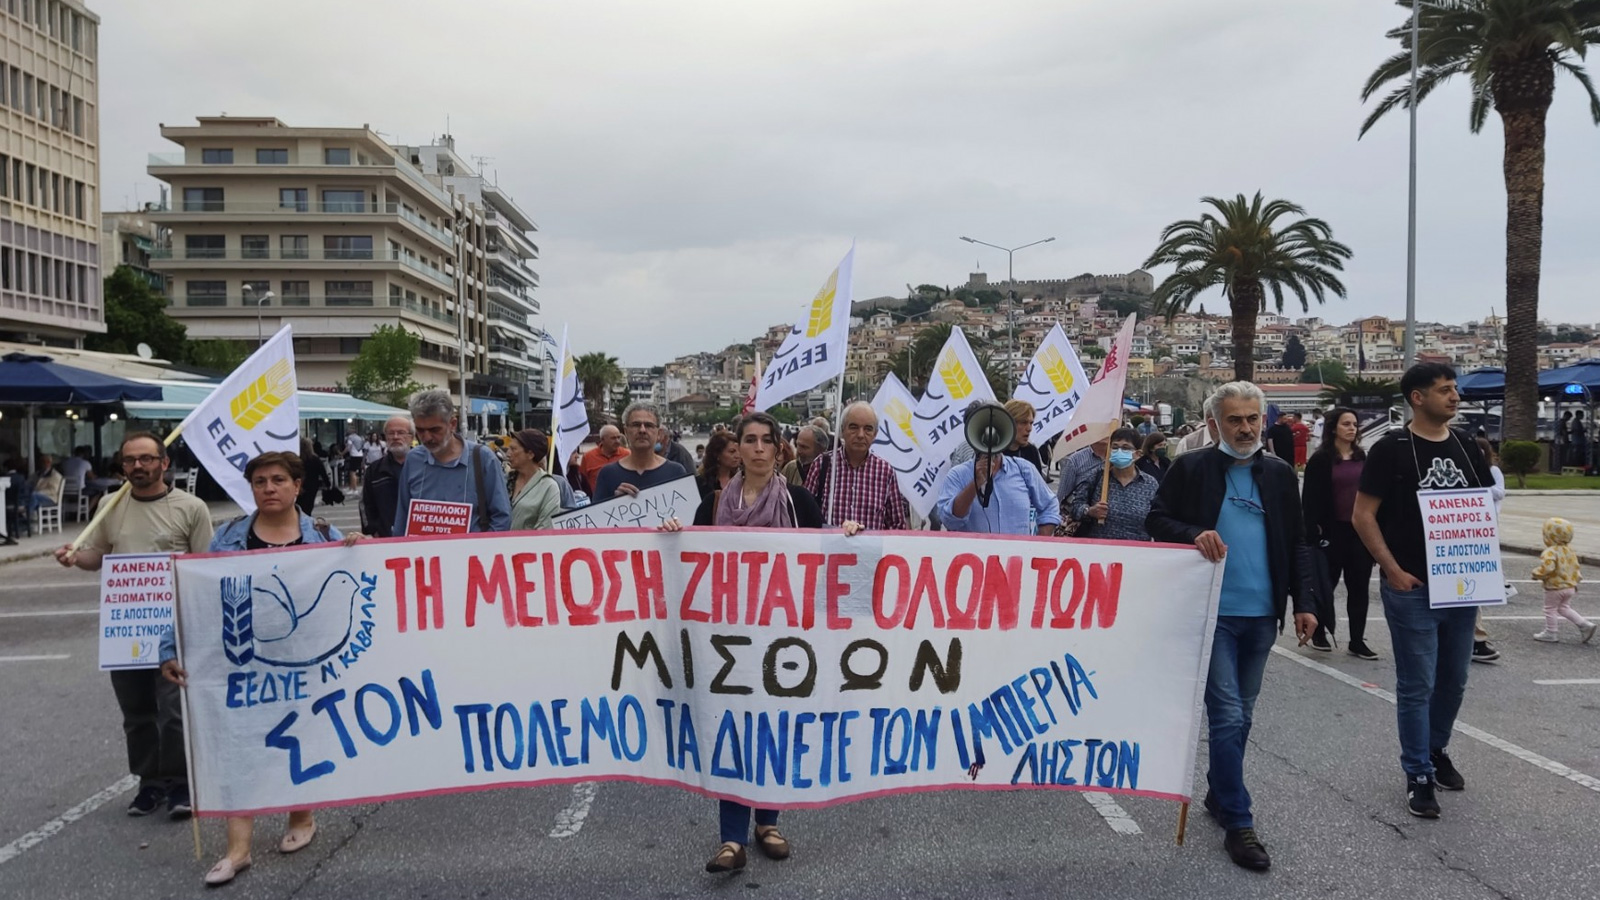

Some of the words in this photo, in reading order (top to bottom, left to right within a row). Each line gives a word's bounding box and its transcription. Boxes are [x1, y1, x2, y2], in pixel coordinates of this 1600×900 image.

[413, 503, 467, 516] ΑΠΕΜΠΛΟΚΗ
[604, 490, 687, 526] ΧΡΟΝΙΑ
[1429, 497, 1486, 510] ΚΑΝΕΝΑΣ
[412, 513, 427, 523] ΤΗΣ
[428, 515, 466, 526] ΕΛΛΑΔΑΣ
[1428, 512, 1482, 524] ΦΑΝΤΑΡΟΣ
[1485, 512, 1491, 521] &
[435, 526, 451, 534] ΤΟΥΣ
[1428, 528, 1496, 540] ΑΞΙΩΜΑΤΙΚΟΣ
[1436, 545, 1446, 557] ΣΕ
[1447, 543, 1490, 557] ΑΠΟΣΤΟΛΗ
[112, 562, 172, 573] ΚΑΝΕΝΑΣ
[1431, 562, 1457, 576] ΕΚΤΟΣ
[1459, 561, 1498, 574] ΣΥΝΟΡΩΝ
[107, 577, 165, 588] ΦΑΝΤΑΡΟΣ
[385, 556, 444, 633] ΤΗ
[466, 548, 668, 628] ΜΕΙΩΣΗ
[680, 551, 858, 631] ΖΗΤΑΤΕ
[872, 553, 1023, 631] ΟΛΩΝ
[1031, 558, 1123, 630] ΤΩΝ
[111, 608, 121, 620] ΣΕ
[123, 607, 172, 620] ΑΠΟΣΤΟΛΗ
[338, 571, 377, 669] ΚΑΒΑΛΑΣ
[104, 626, 133, 638] ΕΚΤΟΣ
[611, 628, 963, 698] ΜΙΣΘΩΝ
[265, 669, 442, 785] ΣΤΟΝ
[454, 695, 647, 773] ΠΟΛΕΜΟ
[656, 698, 702, 772] ΤΑ
[711, 710, 860, 789] ΔΙΝΕΤΕ
[869, 706, 942, 776] ΤΩΝ
[1010, 739, 1140, 790] ΛΗΣΤΩΝ
